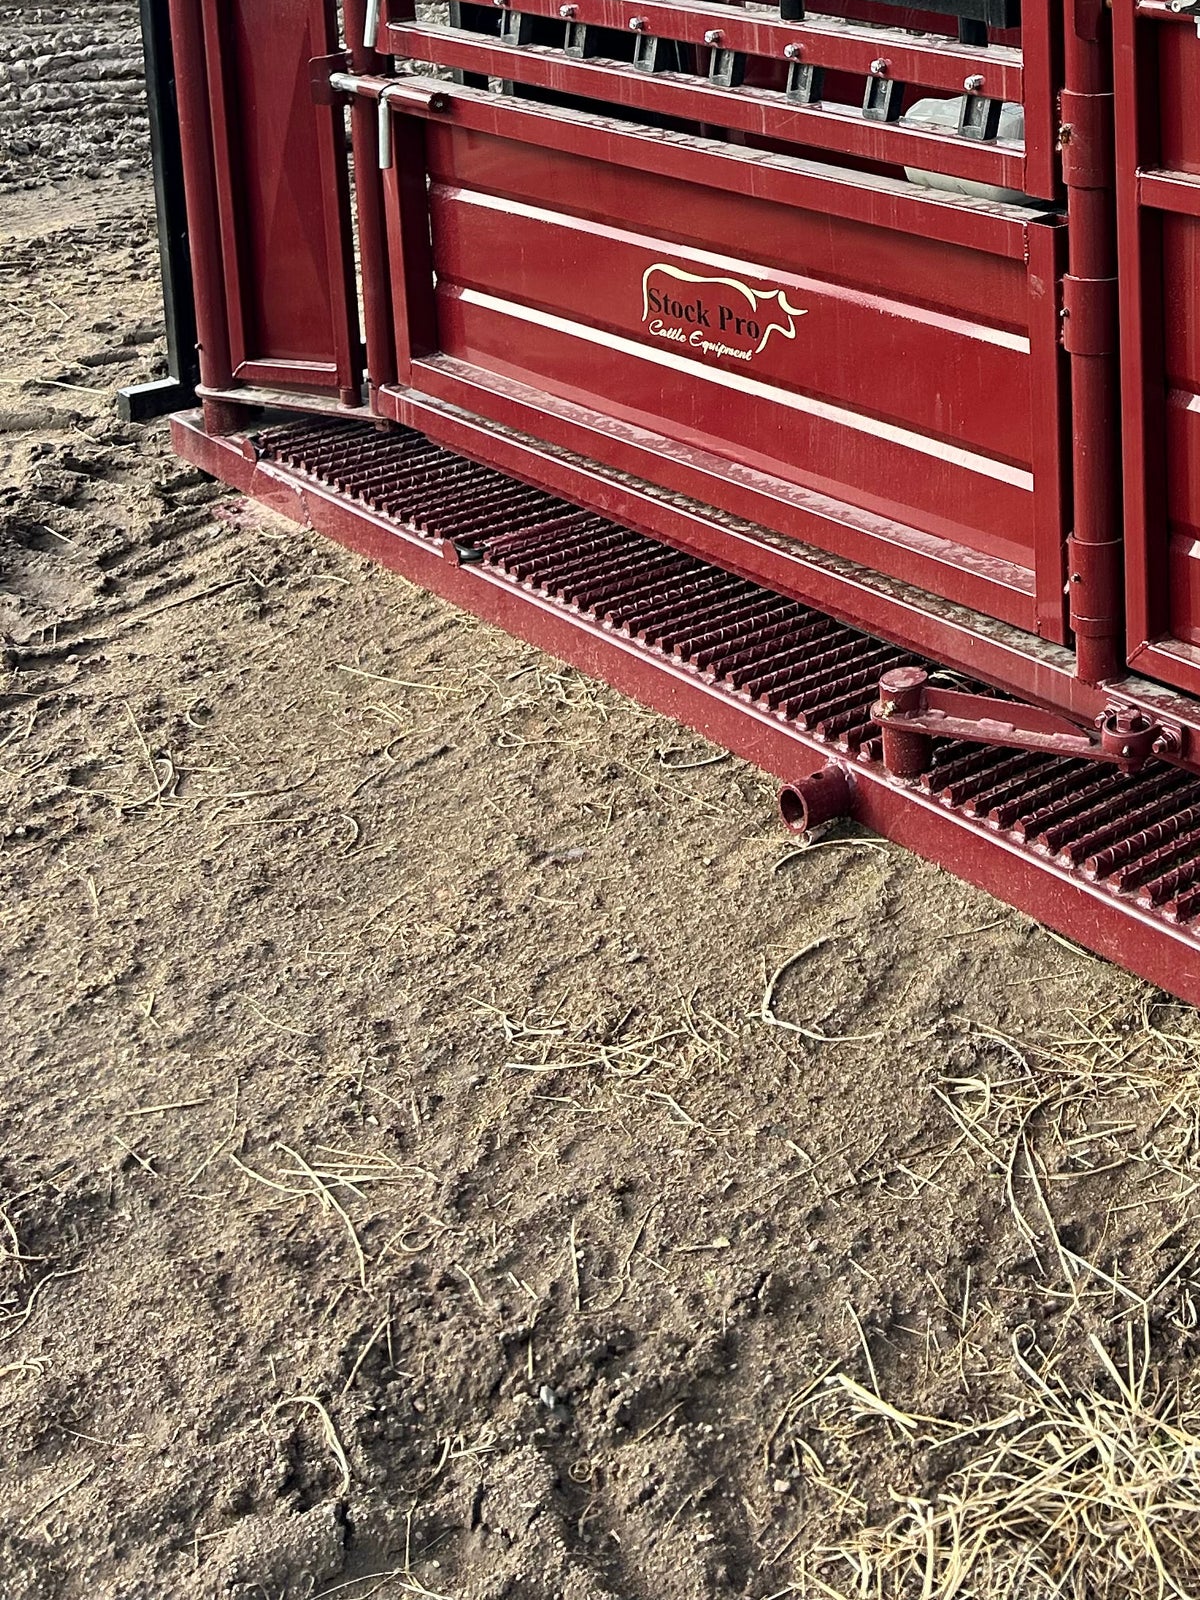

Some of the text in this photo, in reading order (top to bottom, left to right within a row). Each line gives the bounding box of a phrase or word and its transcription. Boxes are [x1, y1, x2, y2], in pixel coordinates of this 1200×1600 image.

[648, 288, 761, 340] Stock Pro
[649, 319, 752, 361] Cattle Equipment
